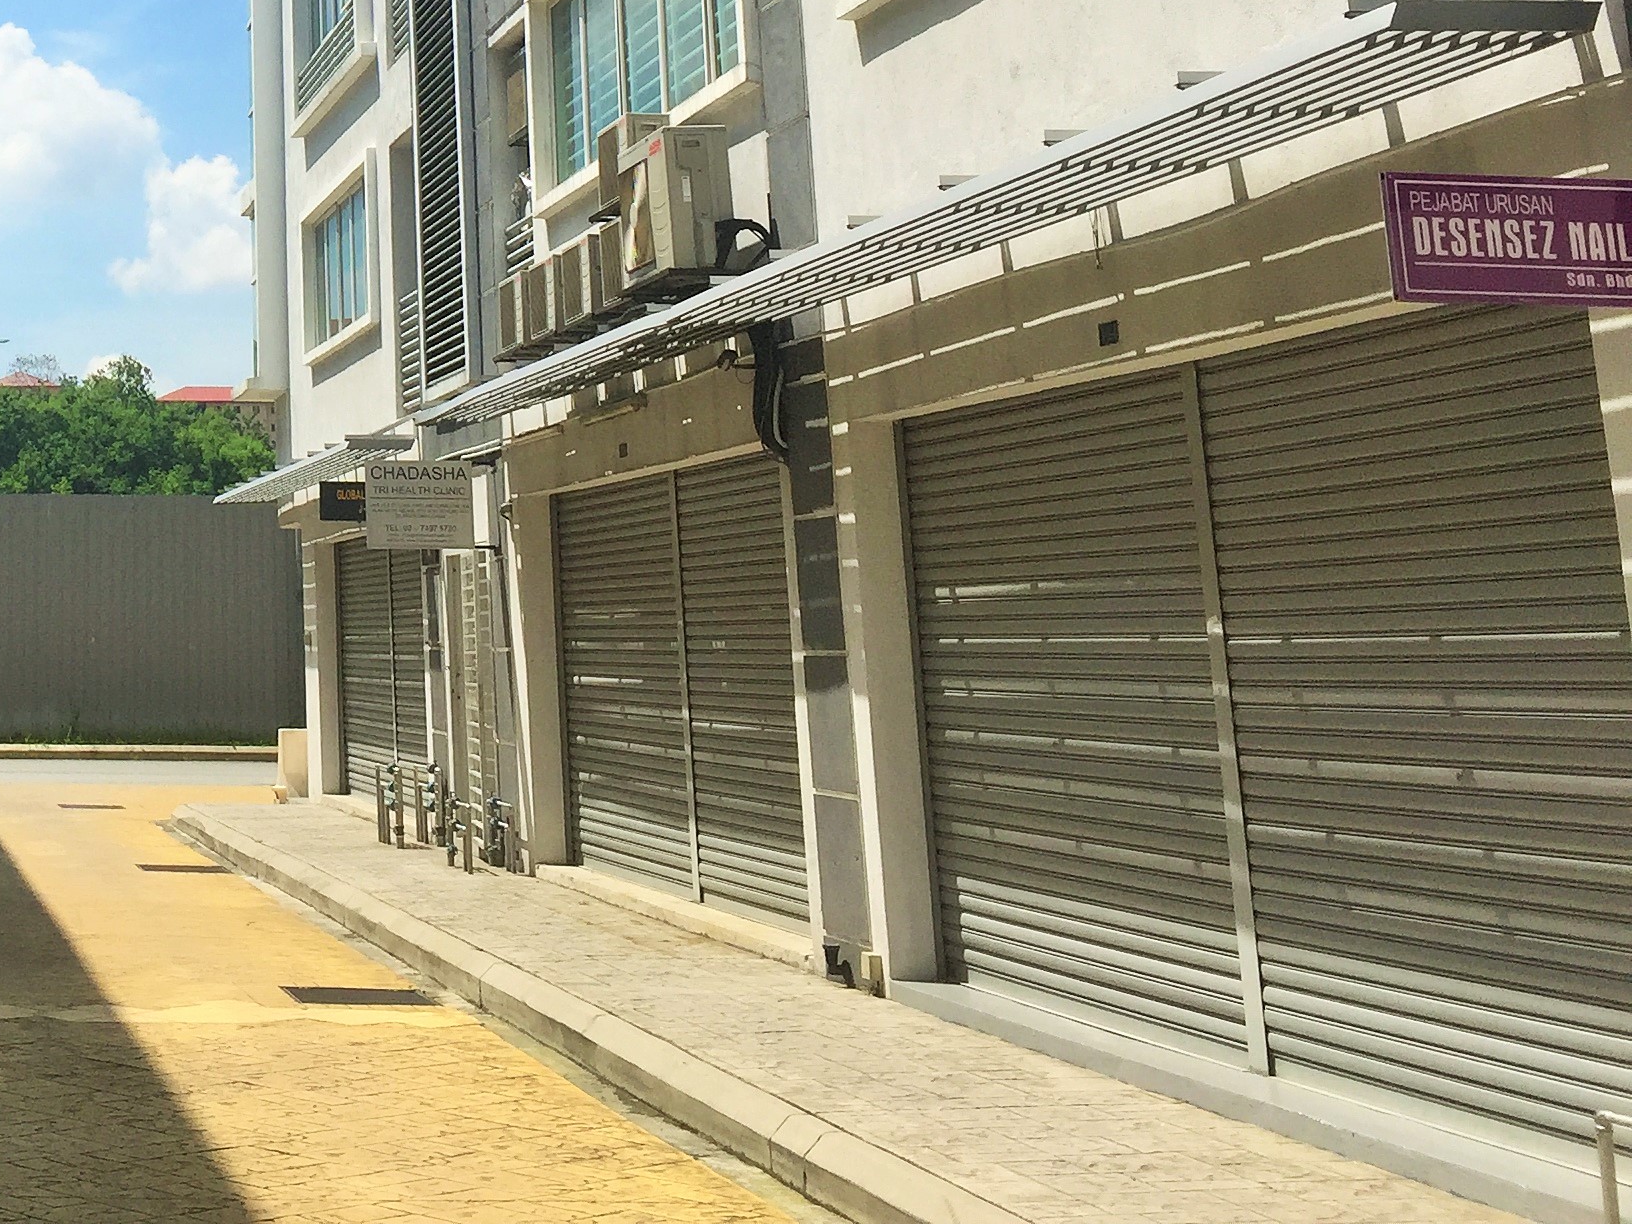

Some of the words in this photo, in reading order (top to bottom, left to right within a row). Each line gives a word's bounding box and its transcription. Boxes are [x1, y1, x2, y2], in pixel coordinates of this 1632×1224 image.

[1409, 191, 1480, 212] PEJABAT
[1485, 193, 1554, 215] URUSAN
[1412, 217, 1557, 260] DESENSEZ
[1568, 221, 1632, 262] NAIL
[1566, 272, 1601, 287] Sdn.
[371, 465, 467, 480] CHADASHA
[336, 489, 366, 500] GLOBAL
[373, 486, 389, 494] TRI
[391, 486, 430, 495] HEALTH
[433, 487, 466, 496] CLINIC
